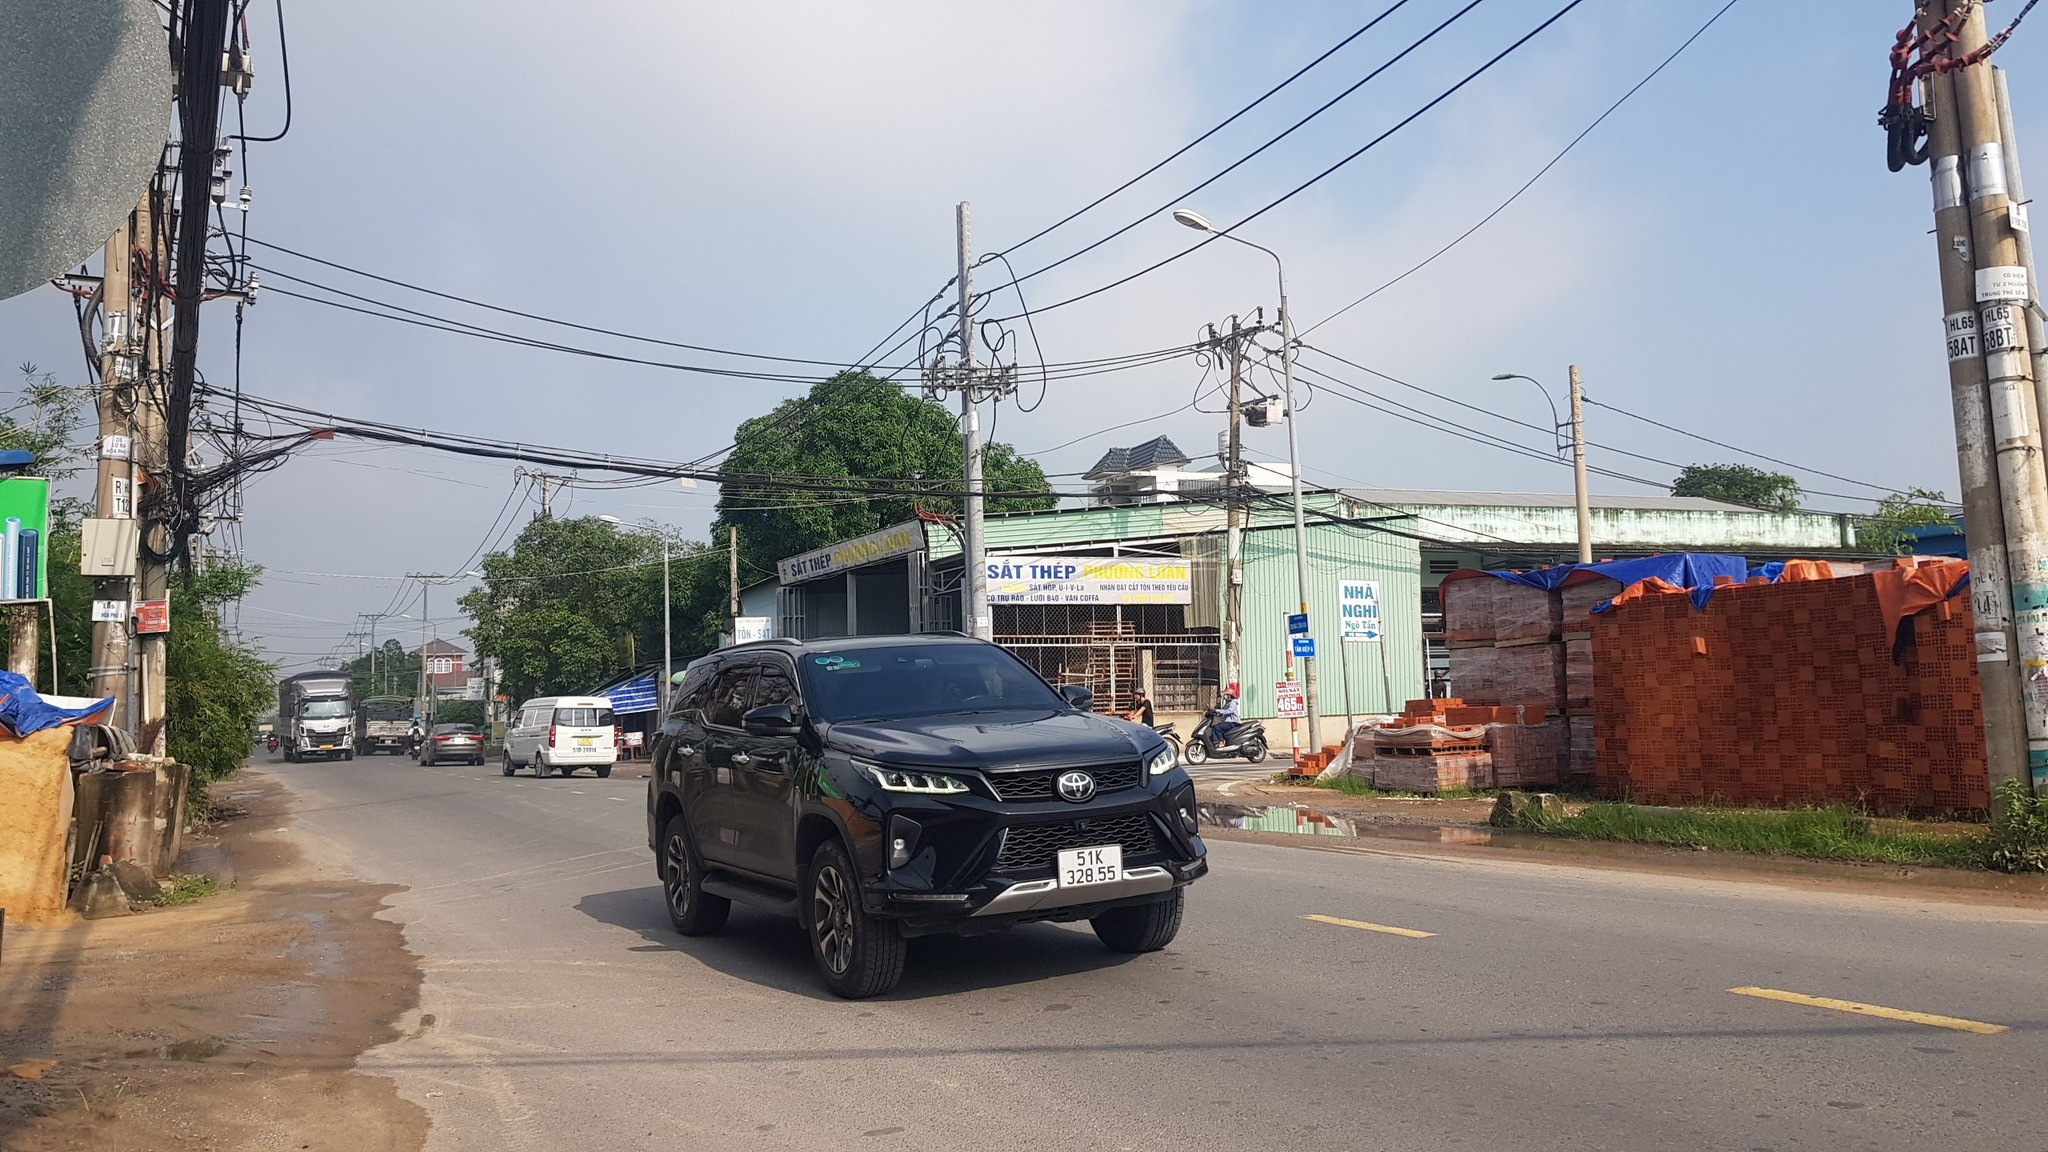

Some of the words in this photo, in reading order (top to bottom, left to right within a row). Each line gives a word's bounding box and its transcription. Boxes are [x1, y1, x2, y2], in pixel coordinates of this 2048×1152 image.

[1985, 307, 2009, 323] HL65
[1950, 316, 1974, 332] HL65
[115, 480, 122, 494] R
[808, 552, 831, 572] THÉP
[987, 559, 1023, 579] SẮT
[1029, 562, 1076, 579] THÉP
[1148, 564, 1187, 579] LOAN
[1344, 583, 1374, 599] NHÀ
[1342, 600, 1377, 618] NGHỈ
[737, 626, 751, 639] TÔN
[1077, 850, 1103, 866] 51K
[1066, 866, 1115, 885] 328.55
